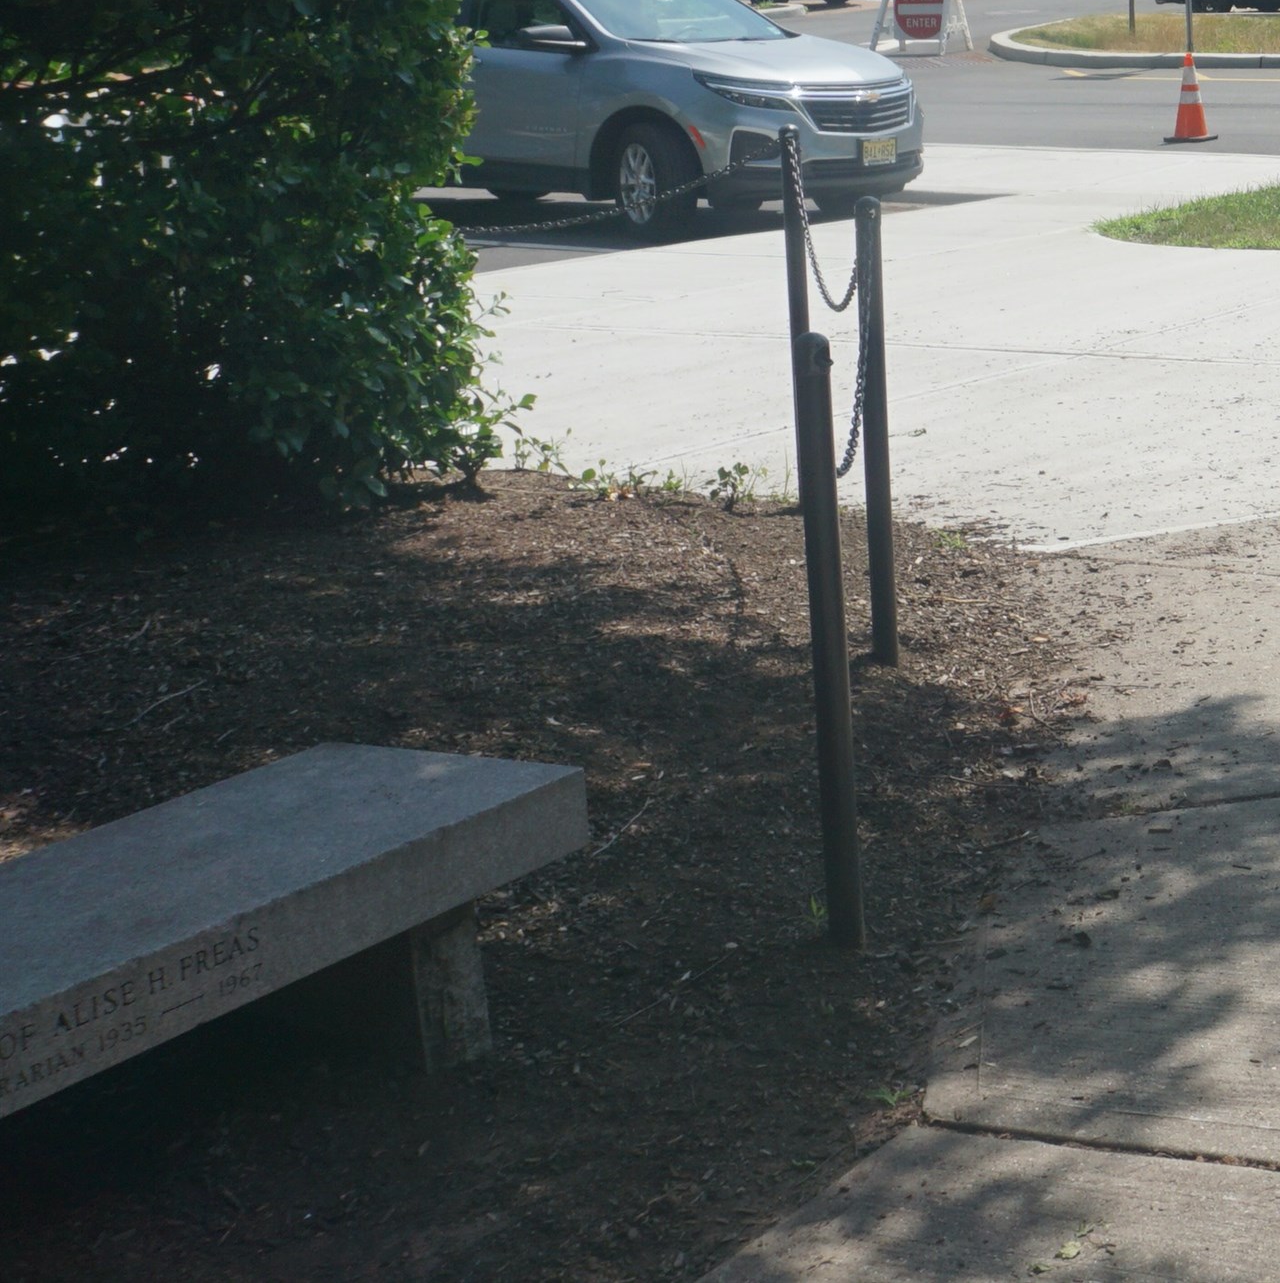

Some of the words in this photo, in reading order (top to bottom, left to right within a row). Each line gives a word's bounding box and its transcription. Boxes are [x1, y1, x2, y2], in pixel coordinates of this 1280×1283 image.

[906, 17, 938, 28] ENTER
[0, 1023, 35, 1060] OF
[54, 981, 136, 1037] ALISE
[148, 966, 174, 995] H.
[180, 926, 260, 981] FREAS
[98, 1015, 147, 1052] 1935
[219, 962, 263, 998] 1967
